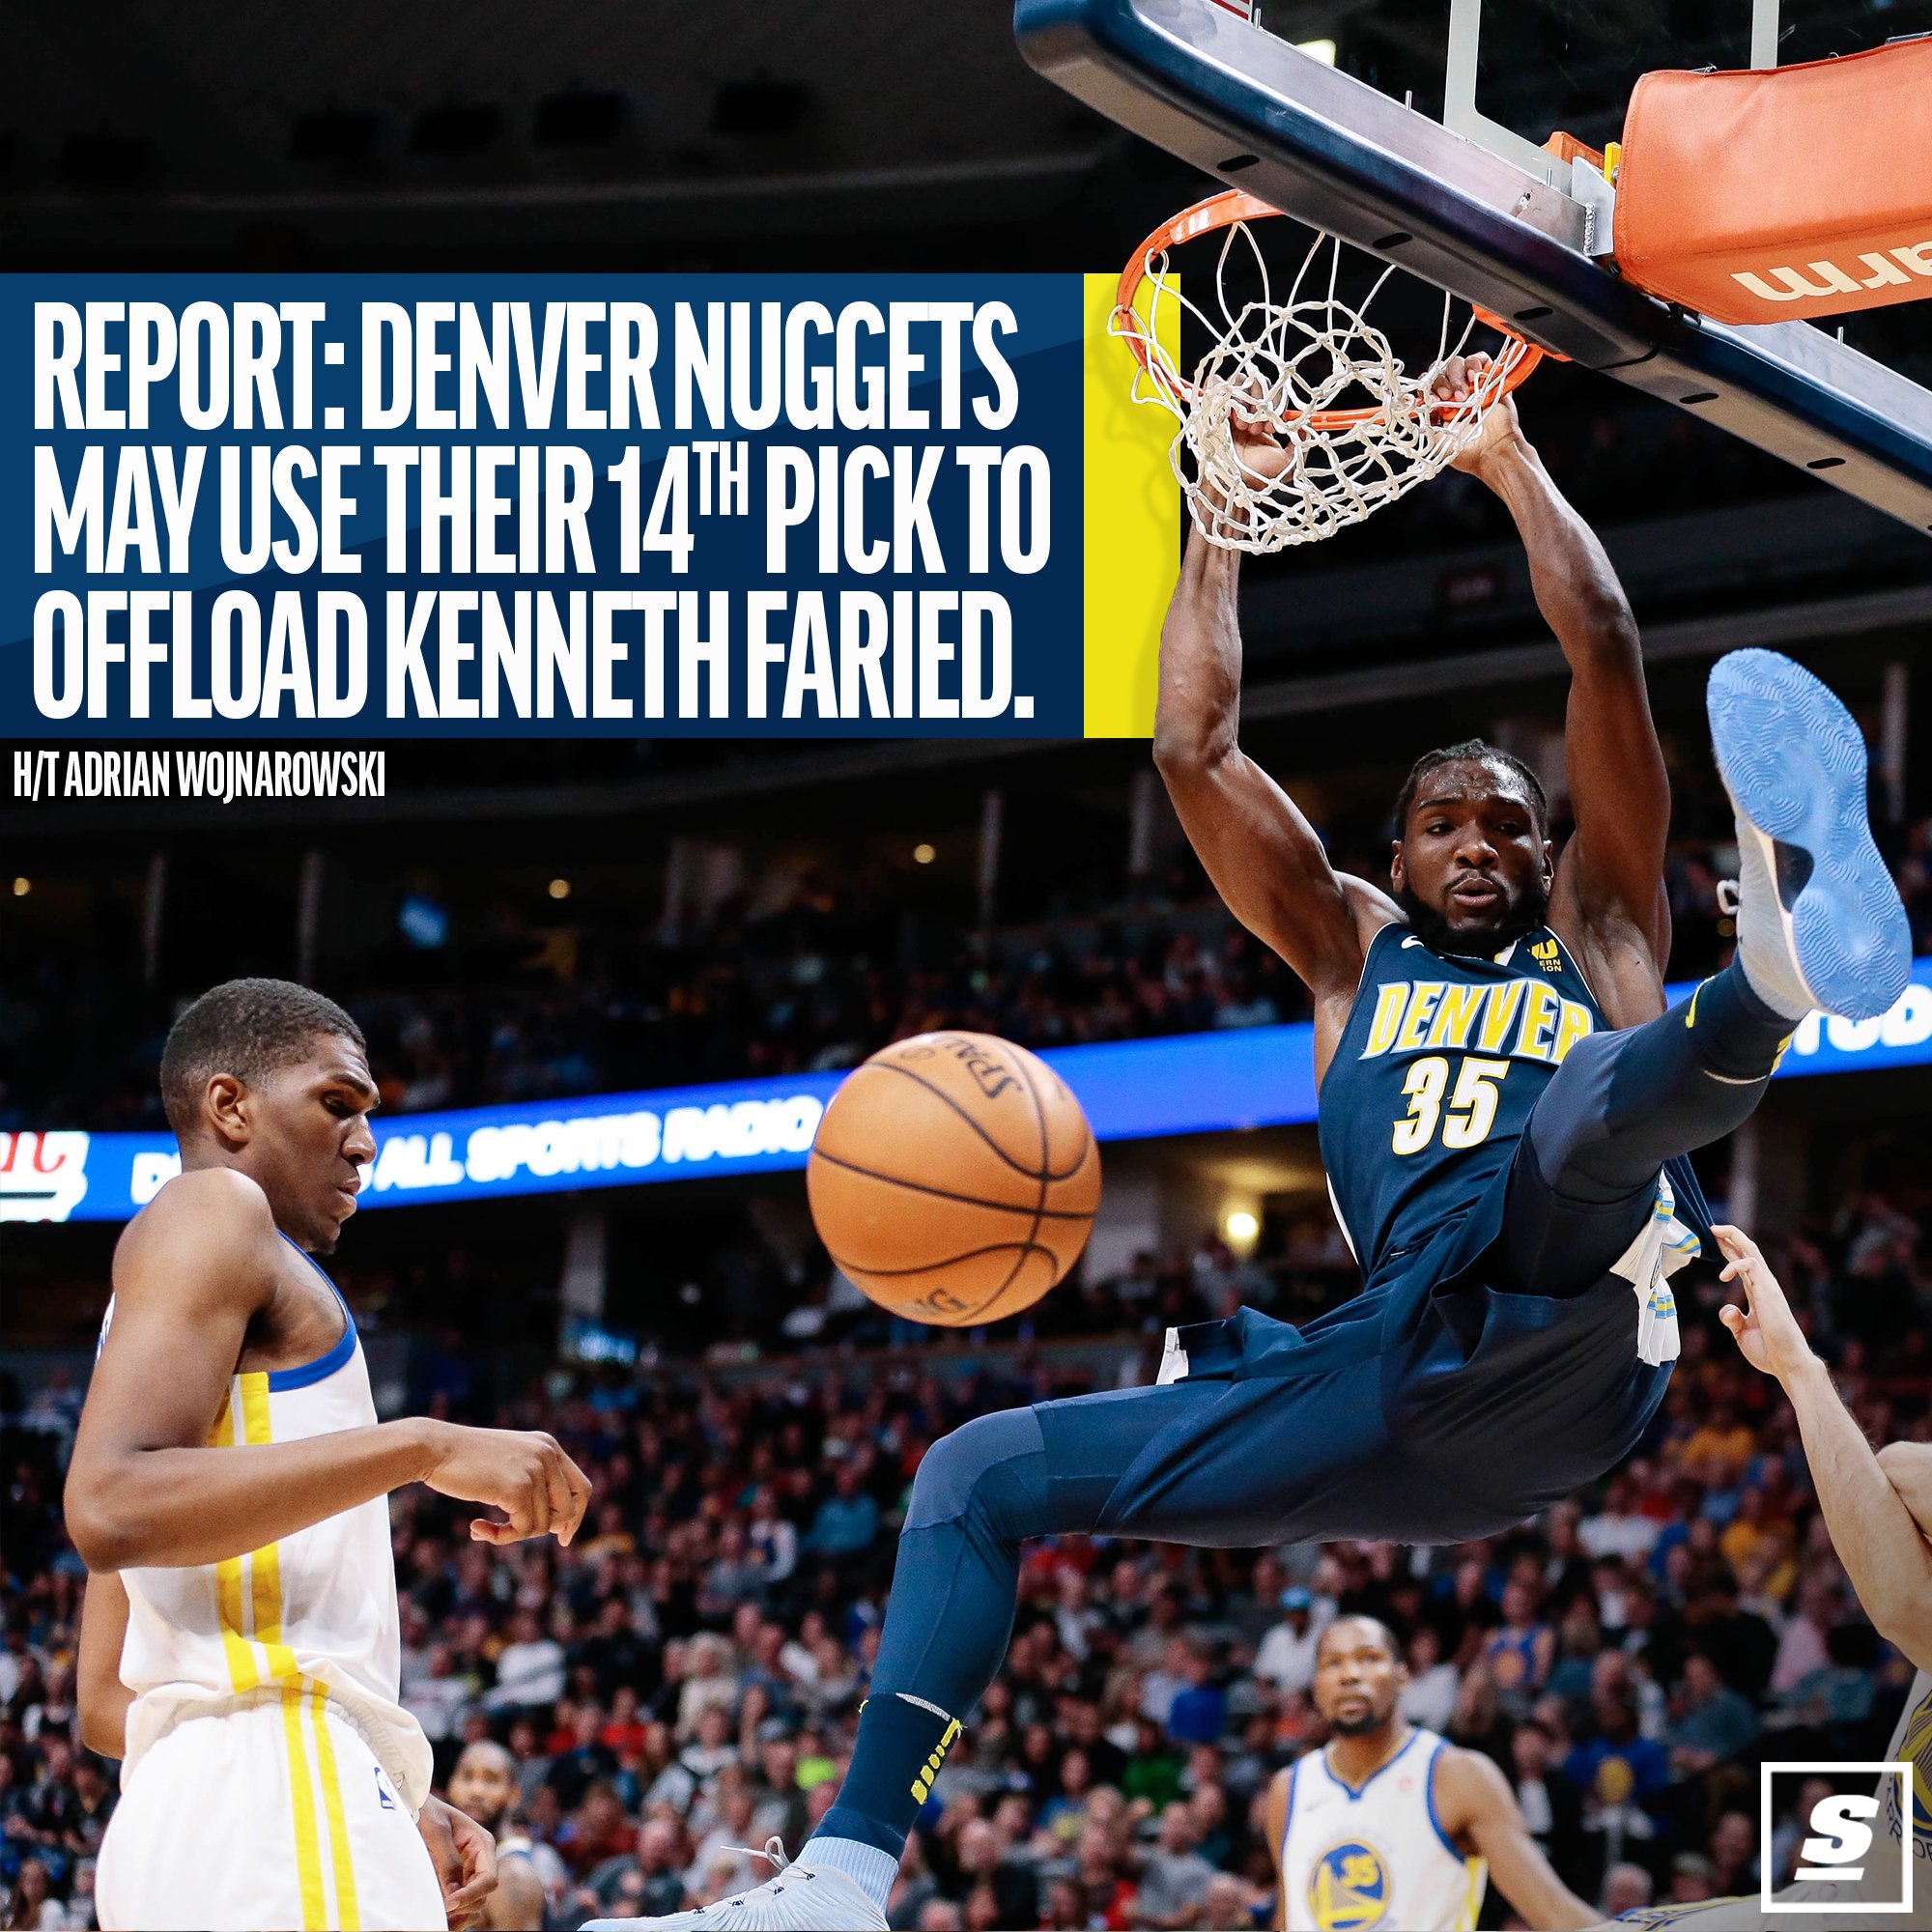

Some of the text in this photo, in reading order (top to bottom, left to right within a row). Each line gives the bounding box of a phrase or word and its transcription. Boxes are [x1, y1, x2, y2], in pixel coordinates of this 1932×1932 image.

[1358, 977, 1594, 1065] DENVER
[373, 1133, 466, 1192] ALL
[467, 1111, 663, 1181] SPORTS
[662, 1094, 823, 1163] RADIO
[1391, 1056, 1510, 1155] 35
